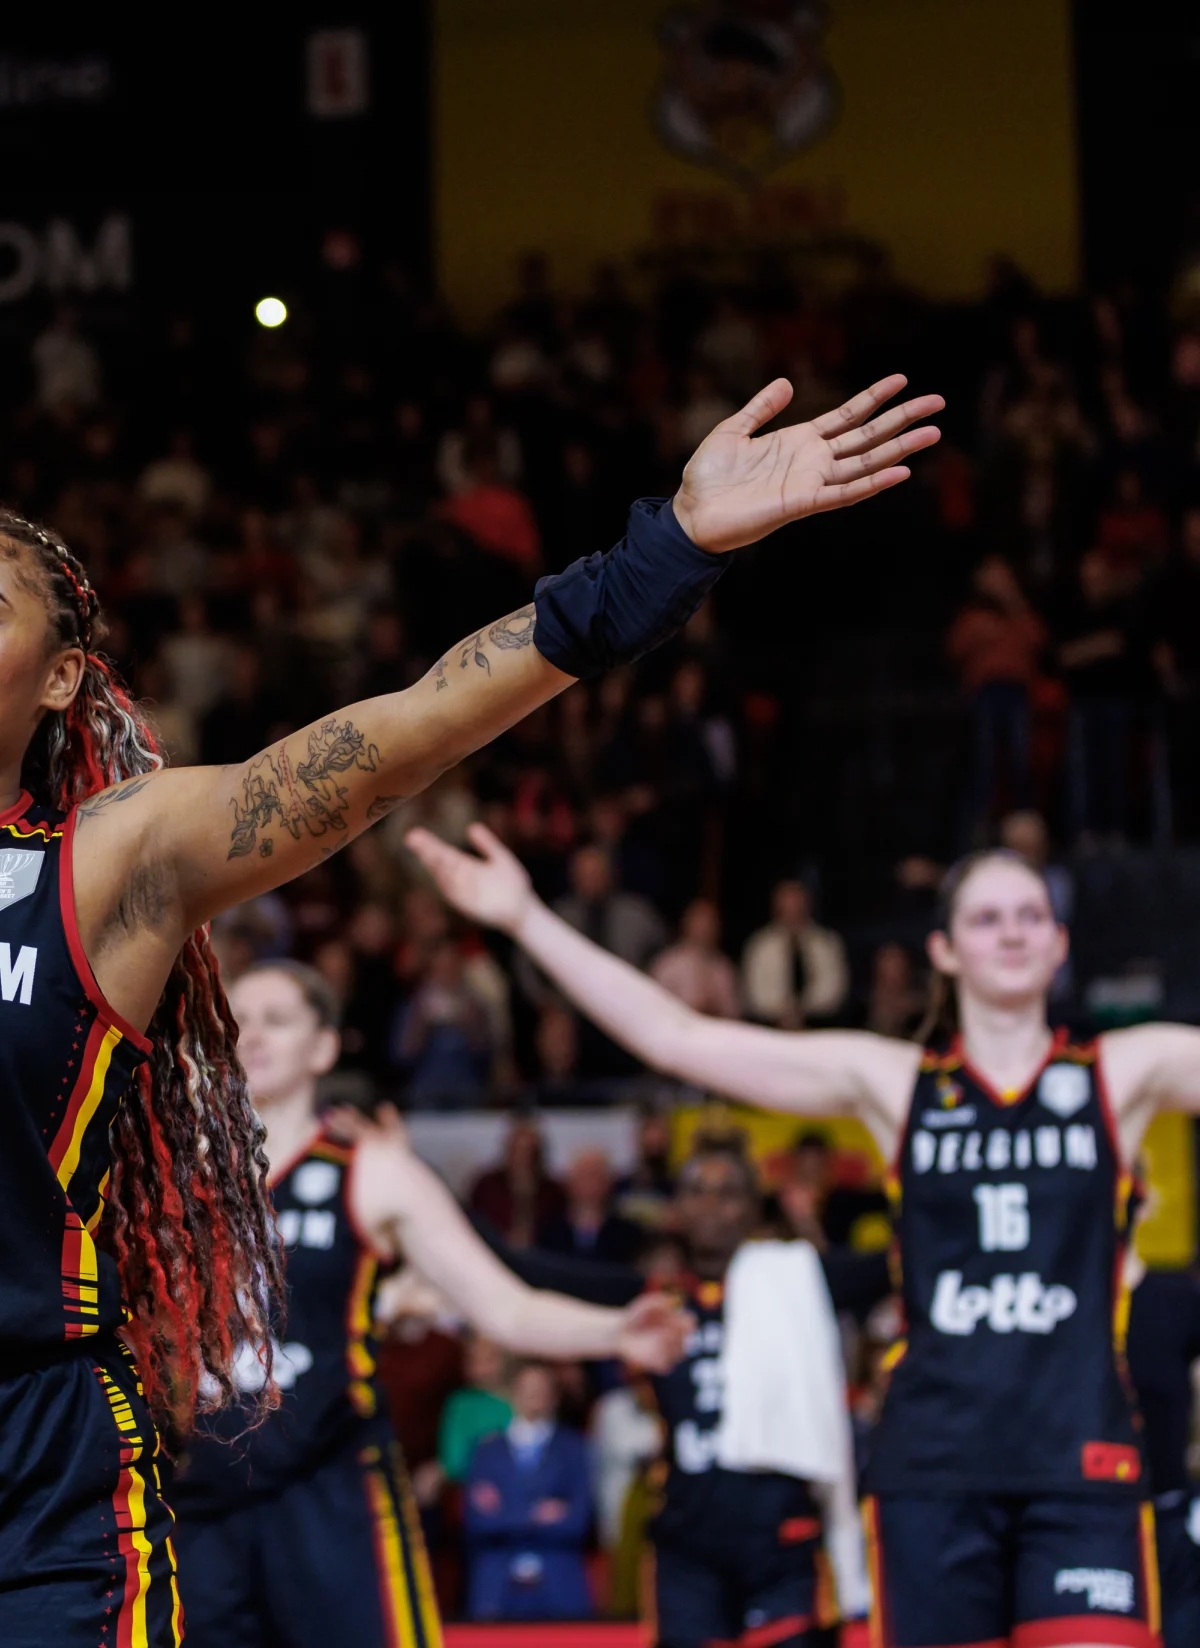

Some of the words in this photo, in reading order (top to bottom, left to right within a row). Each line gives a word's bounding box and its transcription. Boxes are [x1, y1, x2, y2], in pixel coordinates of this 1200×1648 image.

[911, 1124, 1098, 1174] BELGIUM
[973, 1183, 1030, 1251] 16
[930, 1269, 1078, 1336] lotto
